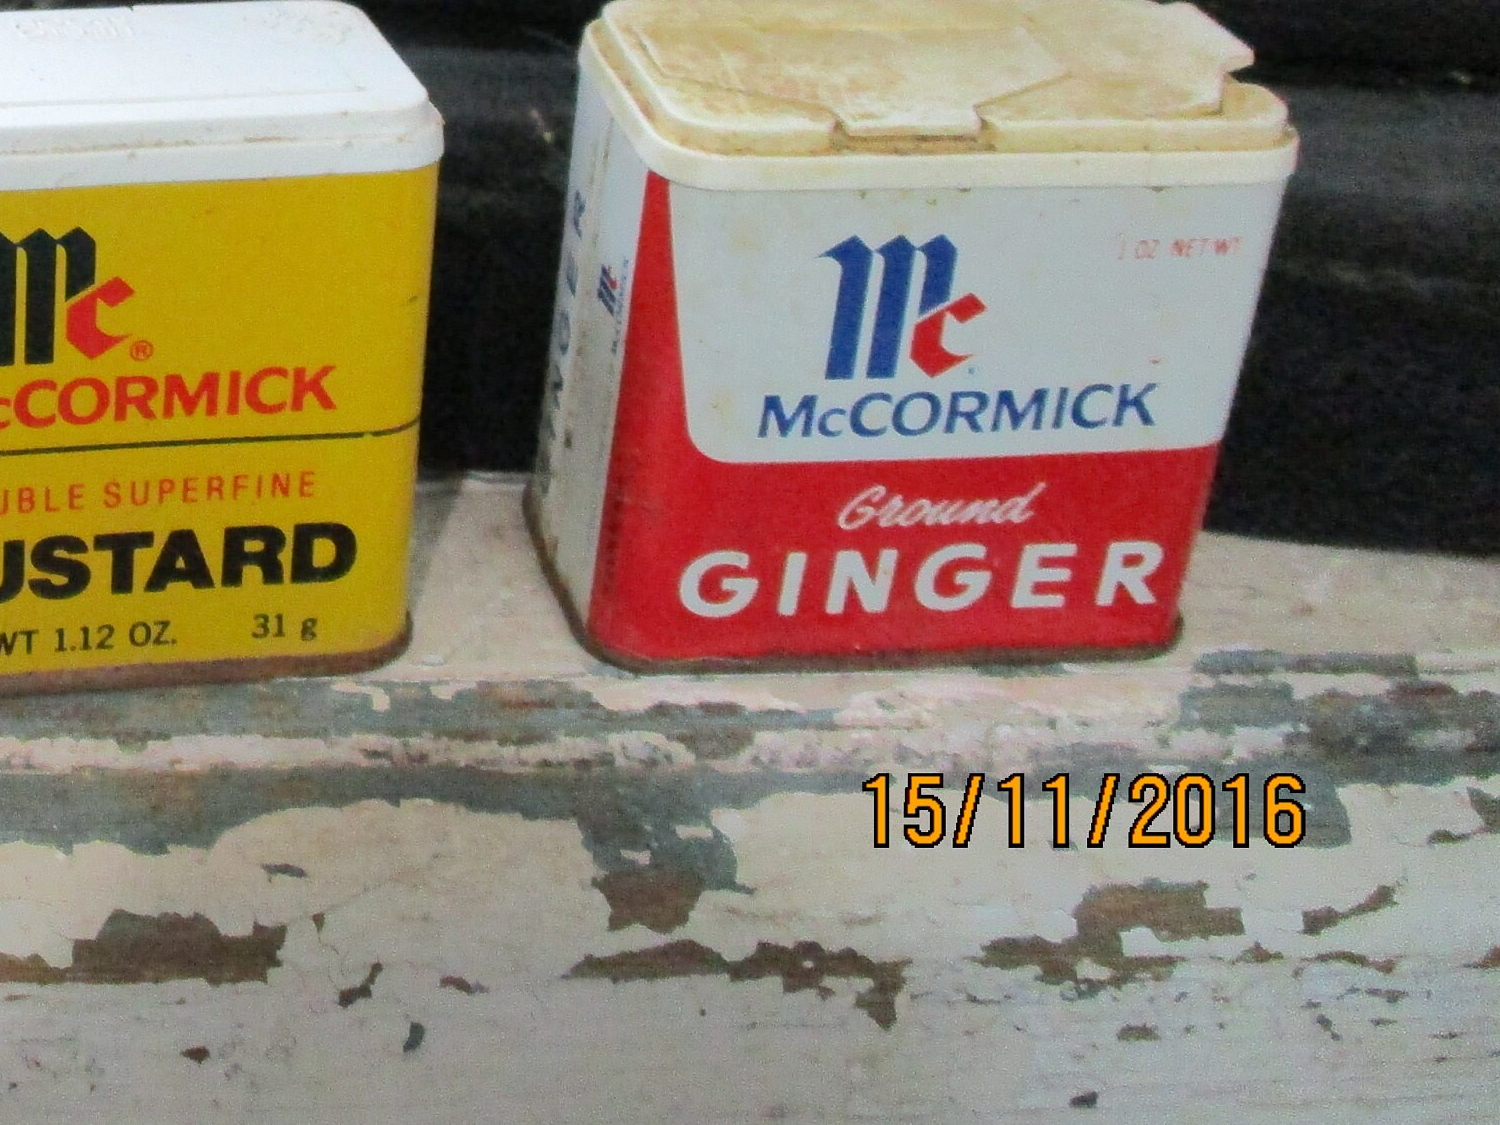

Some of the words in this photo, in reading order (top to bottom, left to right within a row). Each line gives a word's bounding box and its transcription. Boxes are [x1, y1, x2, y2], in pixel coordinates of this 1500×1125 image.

[757, 383, 1160, 438] McCORMICK
[103, 471, 316, 510] SUPERFINE
[836, 482, 1050, 531] Ground
[678, 540, 1165, 617] GINGER
[53, 624, 114, 654] 1.12
[128, 619, 178, 648] OZ.
[251, 613, 285, 639] 31
[301, 615, 318, 641] g
